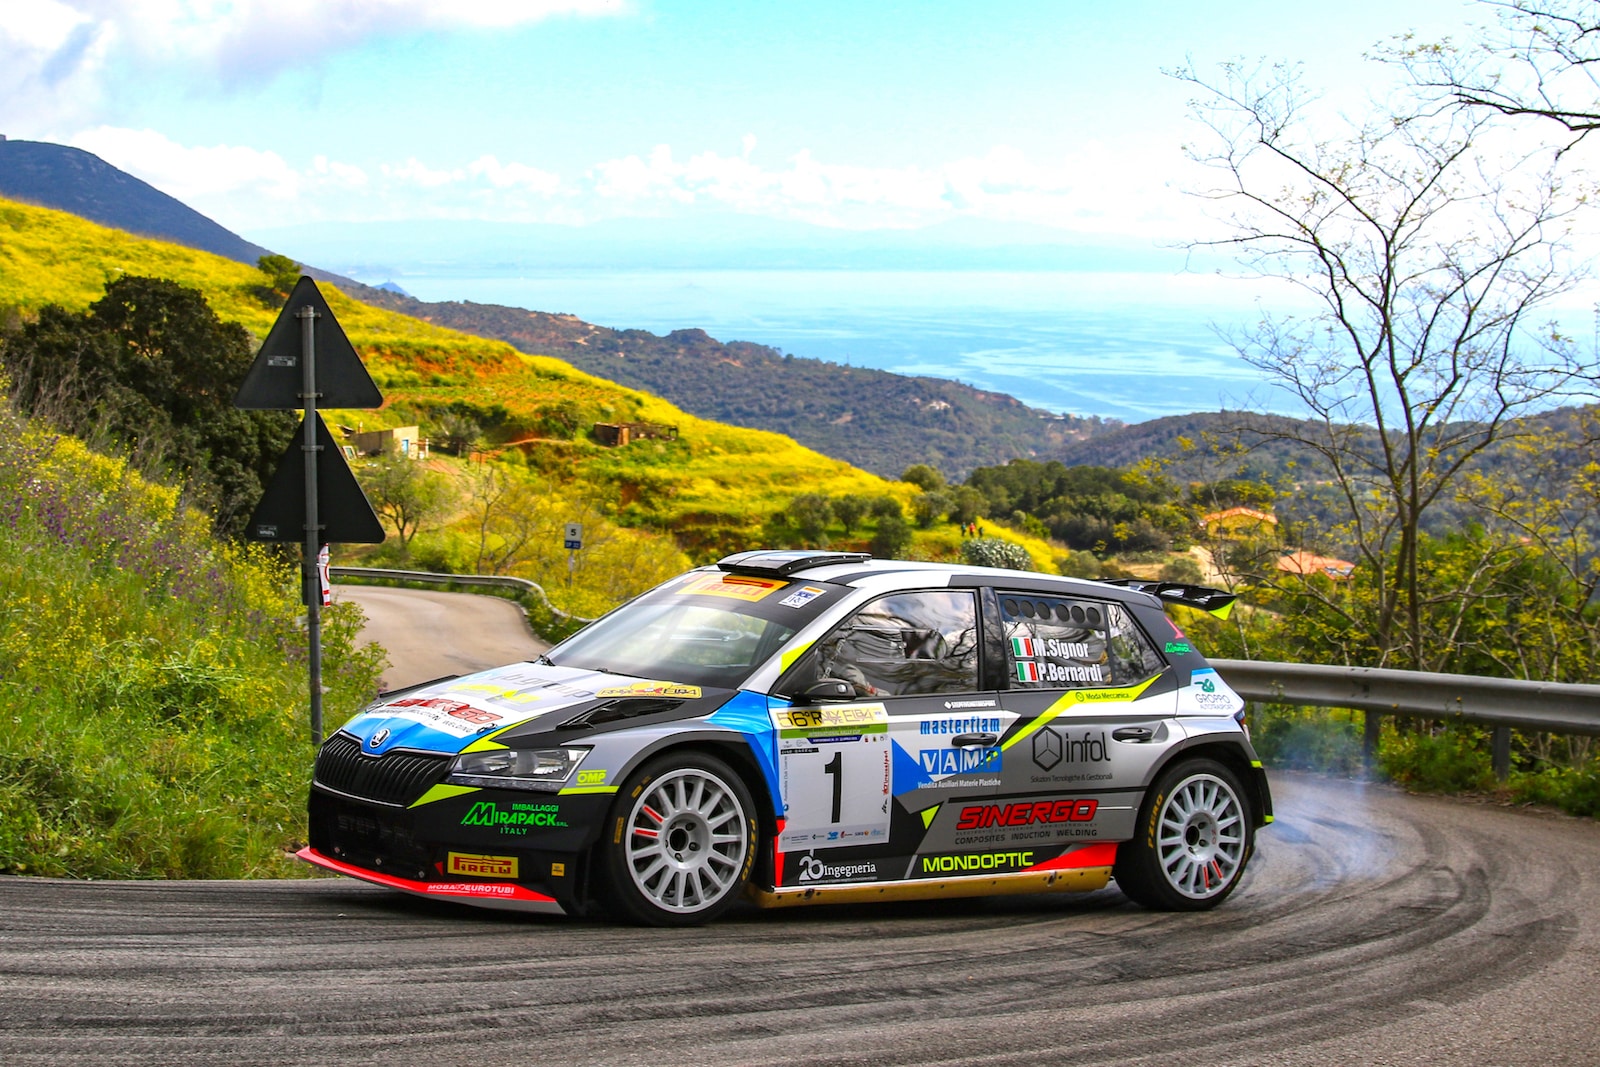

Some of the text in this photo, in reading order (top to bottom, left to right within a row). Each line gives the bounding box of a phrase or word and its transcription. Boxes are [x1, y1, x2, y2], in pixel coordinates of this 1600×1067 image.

[570, 528, 577, 537] 5
[1033, 638, 1089, 659] M.Signor
[1037, 662, 1103, 682] P.Bernardi
[1195, 693, 1231, 703] GROPPO
[920, 716, 1000, 735] masterflam
[1065, 731, 1111, 763] infol
[577, 772, 607, 784] OMP
[824, 751, 842, 824] 1
[460, 801, 558, 827] MIRAPACK
[512, 803, 559, 812] IMBALLAGGI
[956, 799, 1099, 830] SINERGO
[500, 827, 528, 835] ITALY
[955, 829, 1098, 845] COMPOSITES INDUCTION WELDING
[453, 856, 512, 874] PIRELLI
[824, 861, 877, 878] Ingegneria
[922, 851, 1034, 873] MONDOPTIC
[465, 884, 515, 894] EUROTUBI
